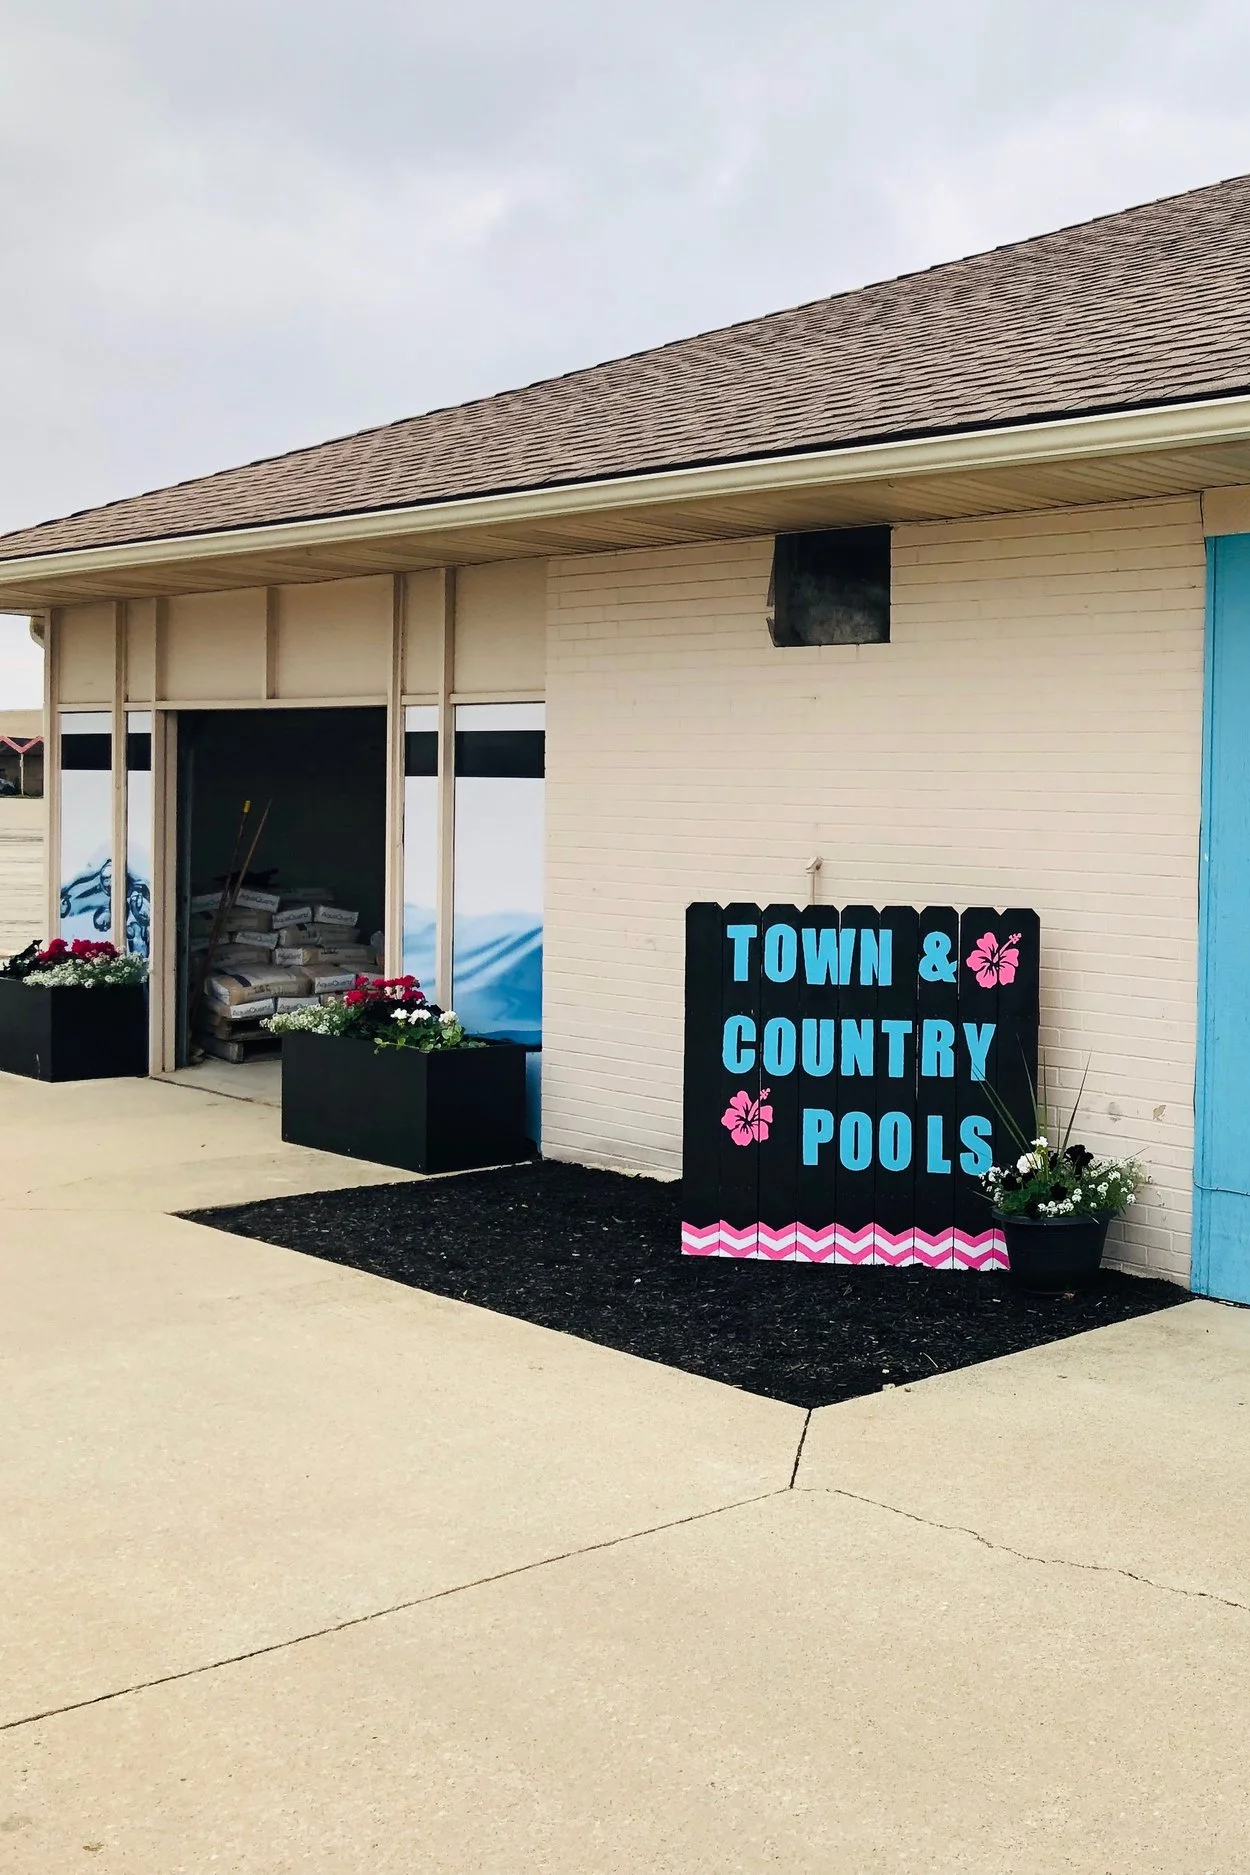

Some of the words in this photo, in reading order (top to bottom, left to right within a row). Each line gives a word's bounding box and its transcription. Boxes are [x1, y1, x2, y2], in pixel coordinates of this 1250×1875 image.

[726, 923, 893, 987] TOWN
[918, 930, 957, 983] &
[722, 1014, 997, 1081] COUNTRY
[802, 1107, 994, 1176] POOLS
